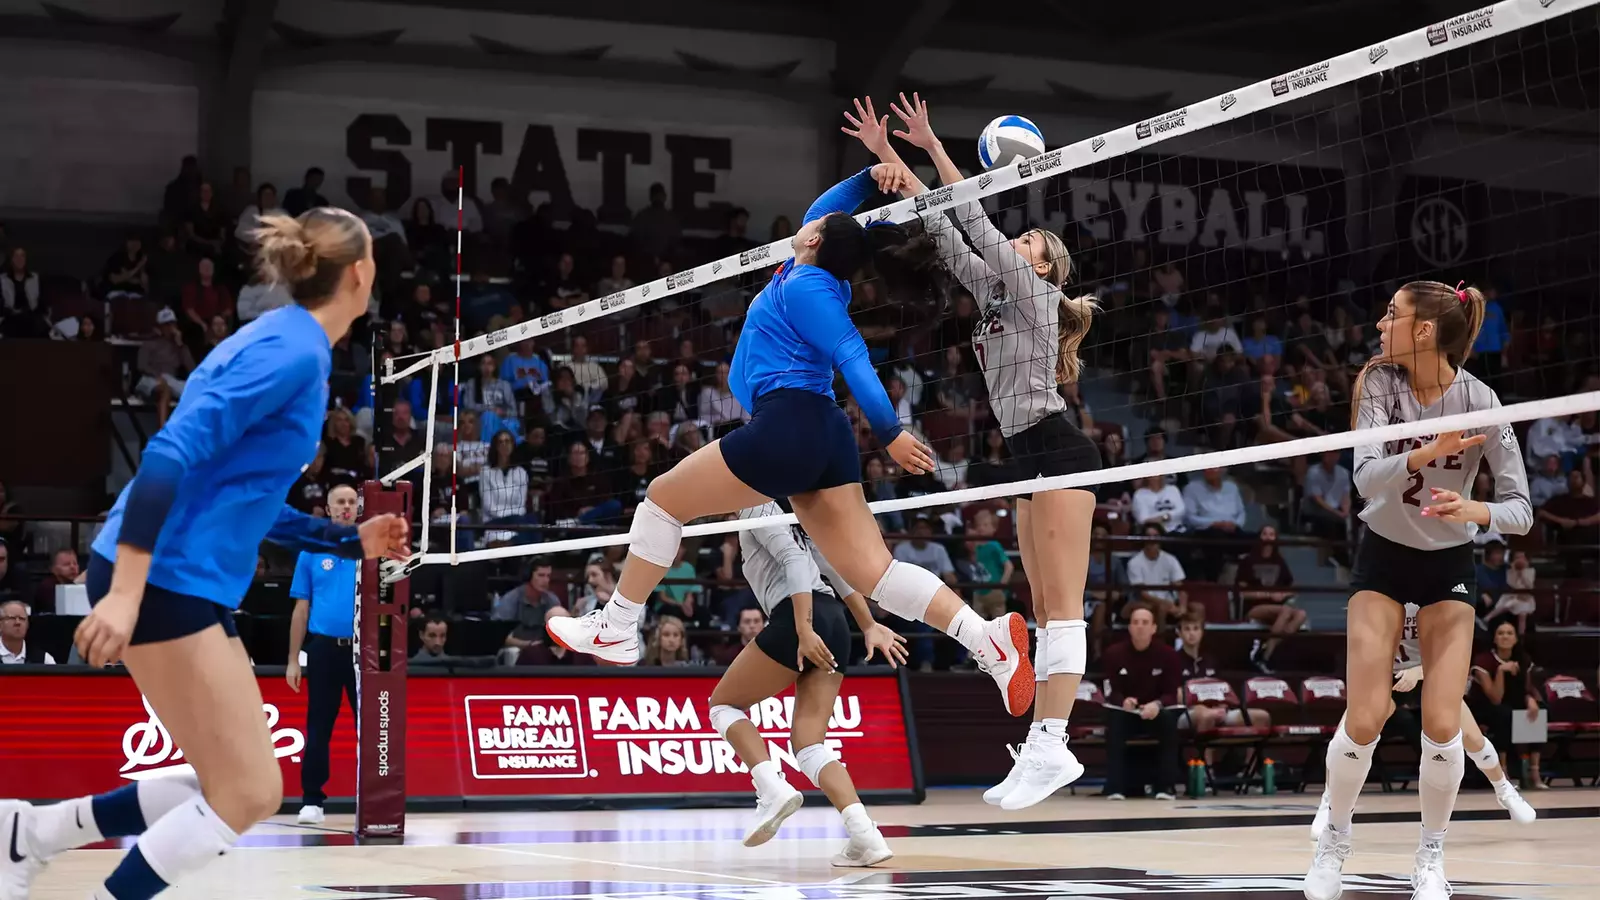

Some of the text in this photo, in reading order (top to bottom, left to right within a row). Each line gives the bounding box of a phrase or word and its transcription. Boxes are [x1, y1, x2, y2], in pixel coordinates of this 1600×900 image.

[1451, 18, 1493, 39] INSURANCE
[1291, 71, 1328, 91] INSURANCE
[1153, 117, 1186, 134] INSURANCE
[347, 113, 732, 228] STATE
[1034, 158, 1062, 174] INSURANCE
[928, 193, 954, 207] INSURANCE
[1402, 471, 1424, 507] 2
[502, 704, 572, 727] FARM
[588, 696, 862, 731] FARM URU
[378, 690, 389, 777] sports imports
[478, 727, 575, 749] BUREAU
[498, 755, 578, 769] INSURANCE
[617, 739, 847, 775] INSURNE
